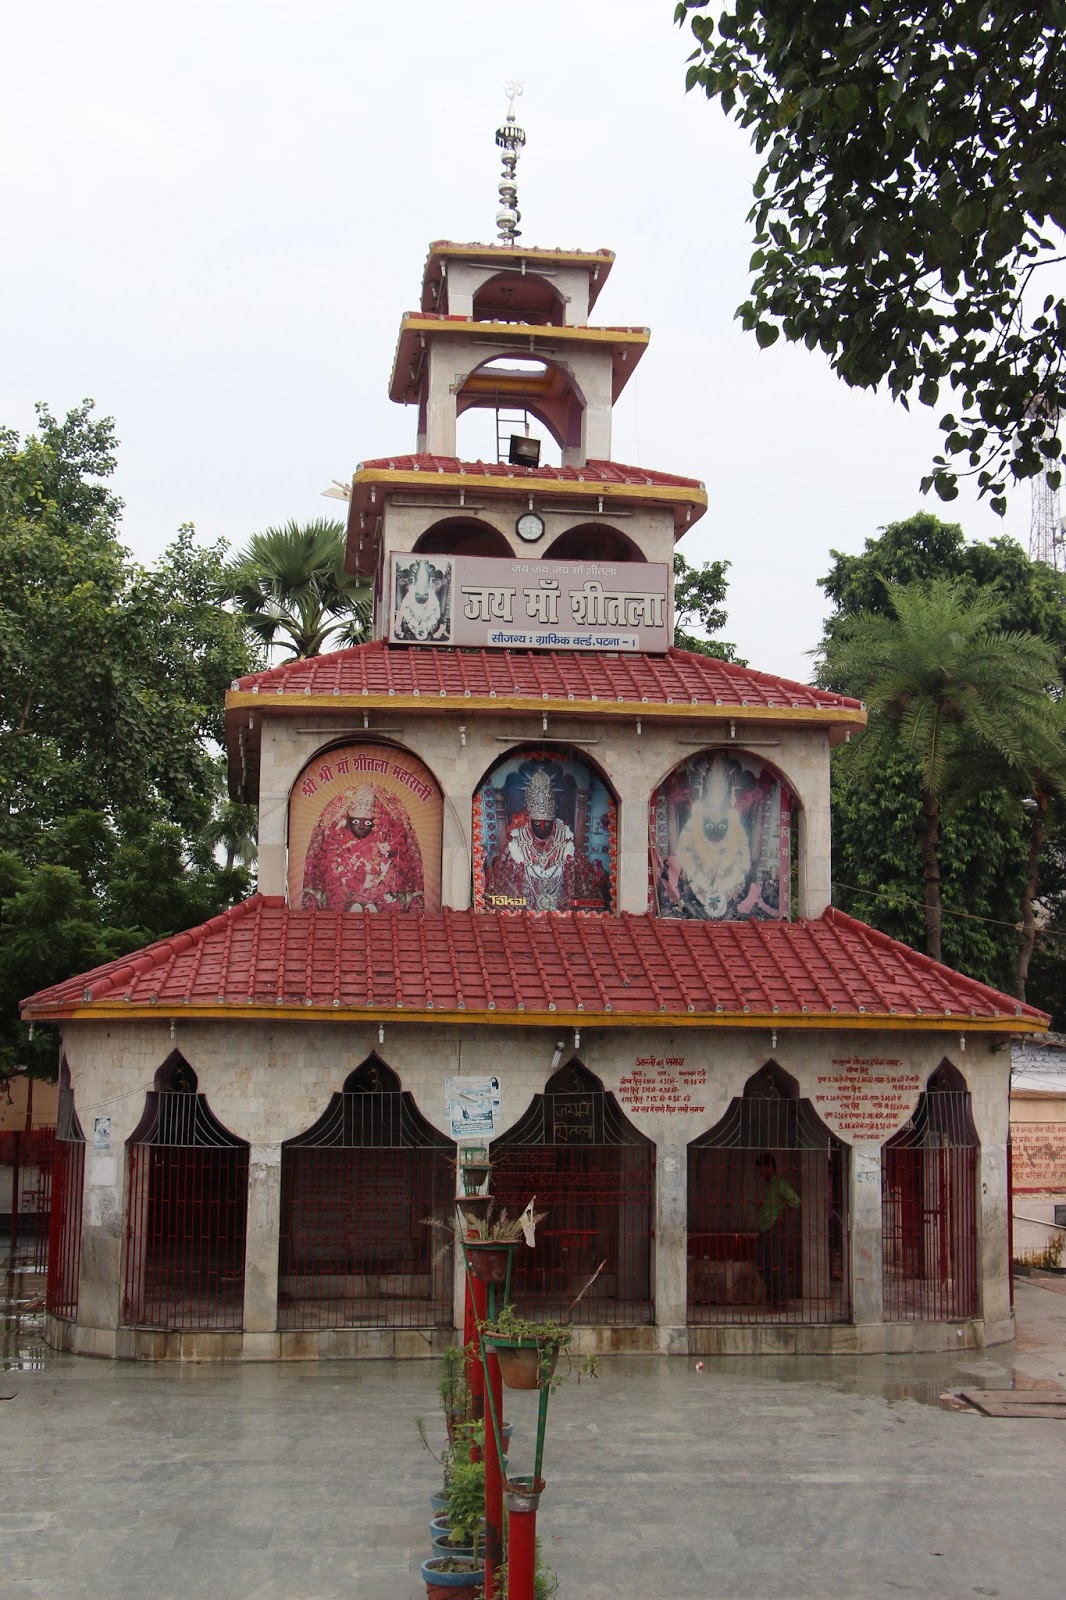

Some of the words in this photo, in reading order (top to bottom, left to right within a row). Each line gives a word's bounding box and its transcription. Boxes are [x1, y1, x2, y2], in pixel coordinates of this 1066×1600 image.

[511, 564, 528, 574] जय
[532, 566, 549, 574] जय
[552, 566, 570, 575] जय
[572, 564, 584, 575] माँ
[586, 564, 617, 576] शीतला
[460, 586, 516, 622] जय
[522, 579, 560, 624] माँ
[568, 580, 664, 627] शीतला
[492, 632, 526, 644] सौजन्य
[536, 633, 570, 646] ग्राफिक
[302, 777, 318, 798] श्री
[318, 765, 334, 785] श्री
[335, 756, 350, 774] माँ
[353, 754, 390, 775] शीतला
[392, 764, 433, 802] महारानी
[489, 896, 527, 906] Takai
